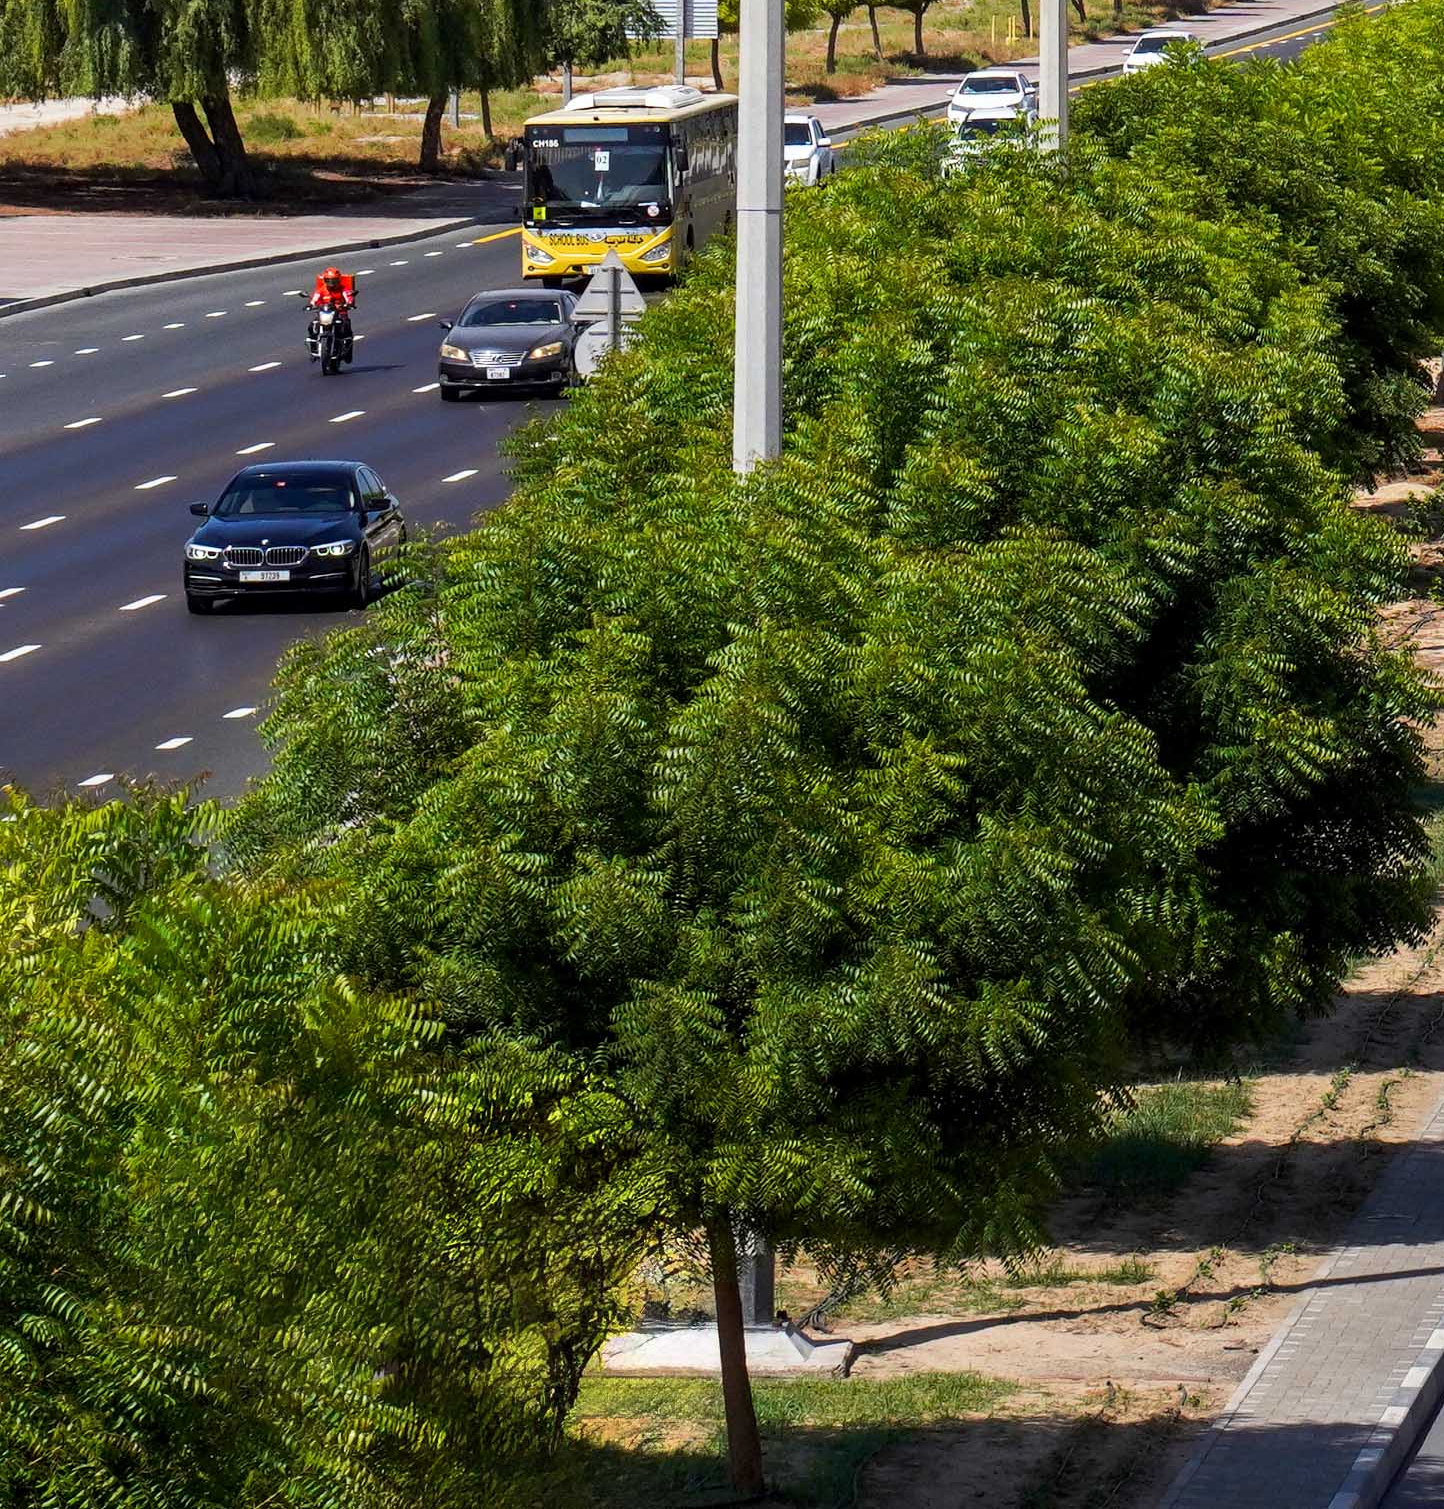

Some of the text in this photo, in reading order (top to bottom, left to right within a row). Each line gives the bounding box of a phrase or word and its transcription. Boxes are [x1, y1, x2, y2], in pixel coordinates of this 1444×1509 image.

[596, 154, 608, 165] 02
[549, 233, 589, 246] SCHOOL BUS
